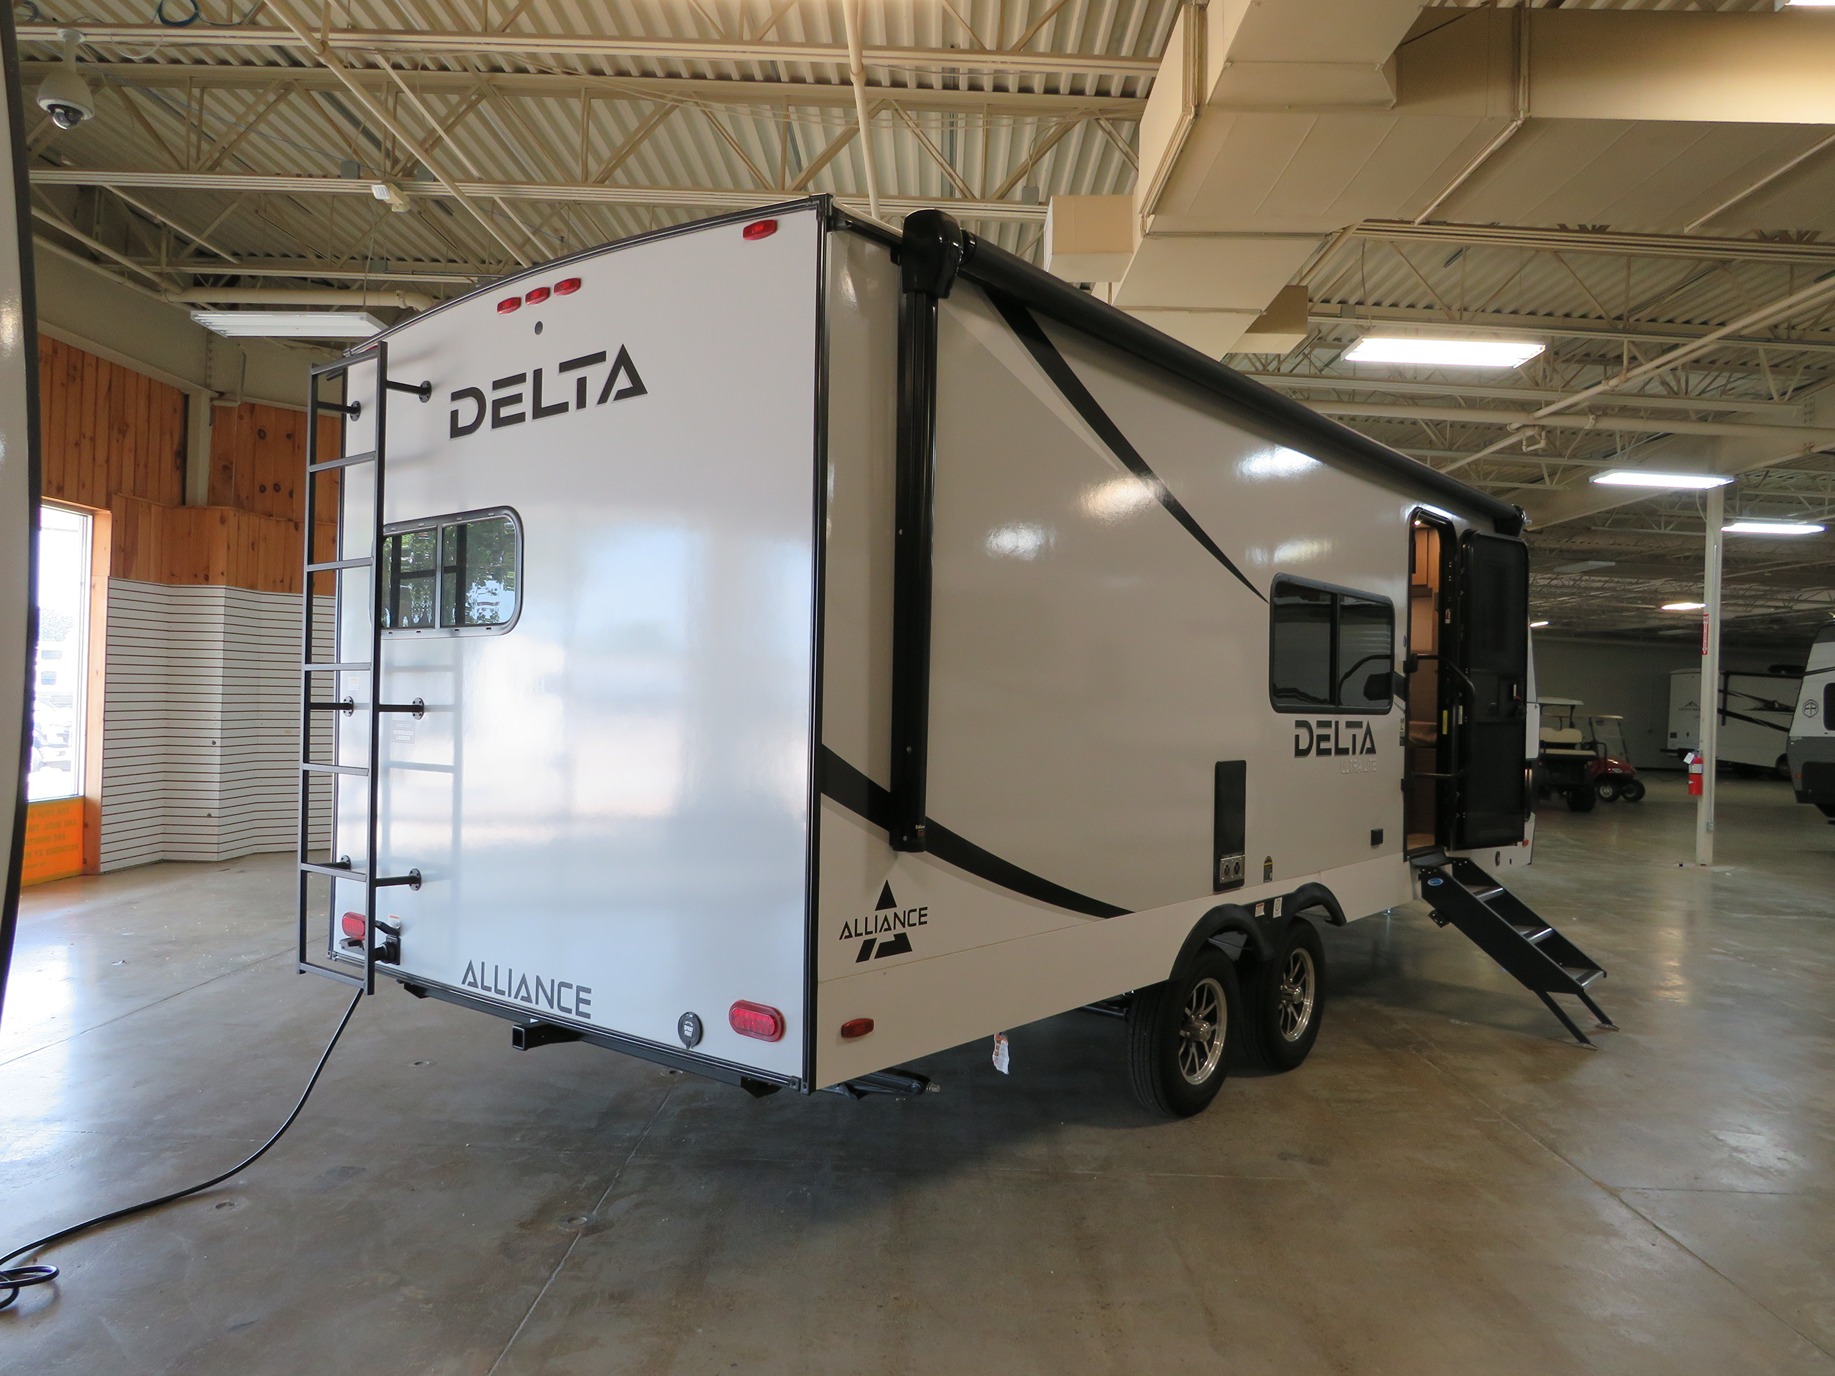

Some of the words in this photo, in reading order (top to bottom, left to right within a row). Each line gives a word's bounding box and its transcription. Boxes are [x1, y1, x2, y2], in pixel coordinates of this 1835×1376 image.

[450, 344, 648, 439] DELTA
[1294, 720, 1377, 757] DELTA
[839, 906, 928, 941] ALLIANCE
[461, 959, 592, 1020] ALLIANCE
